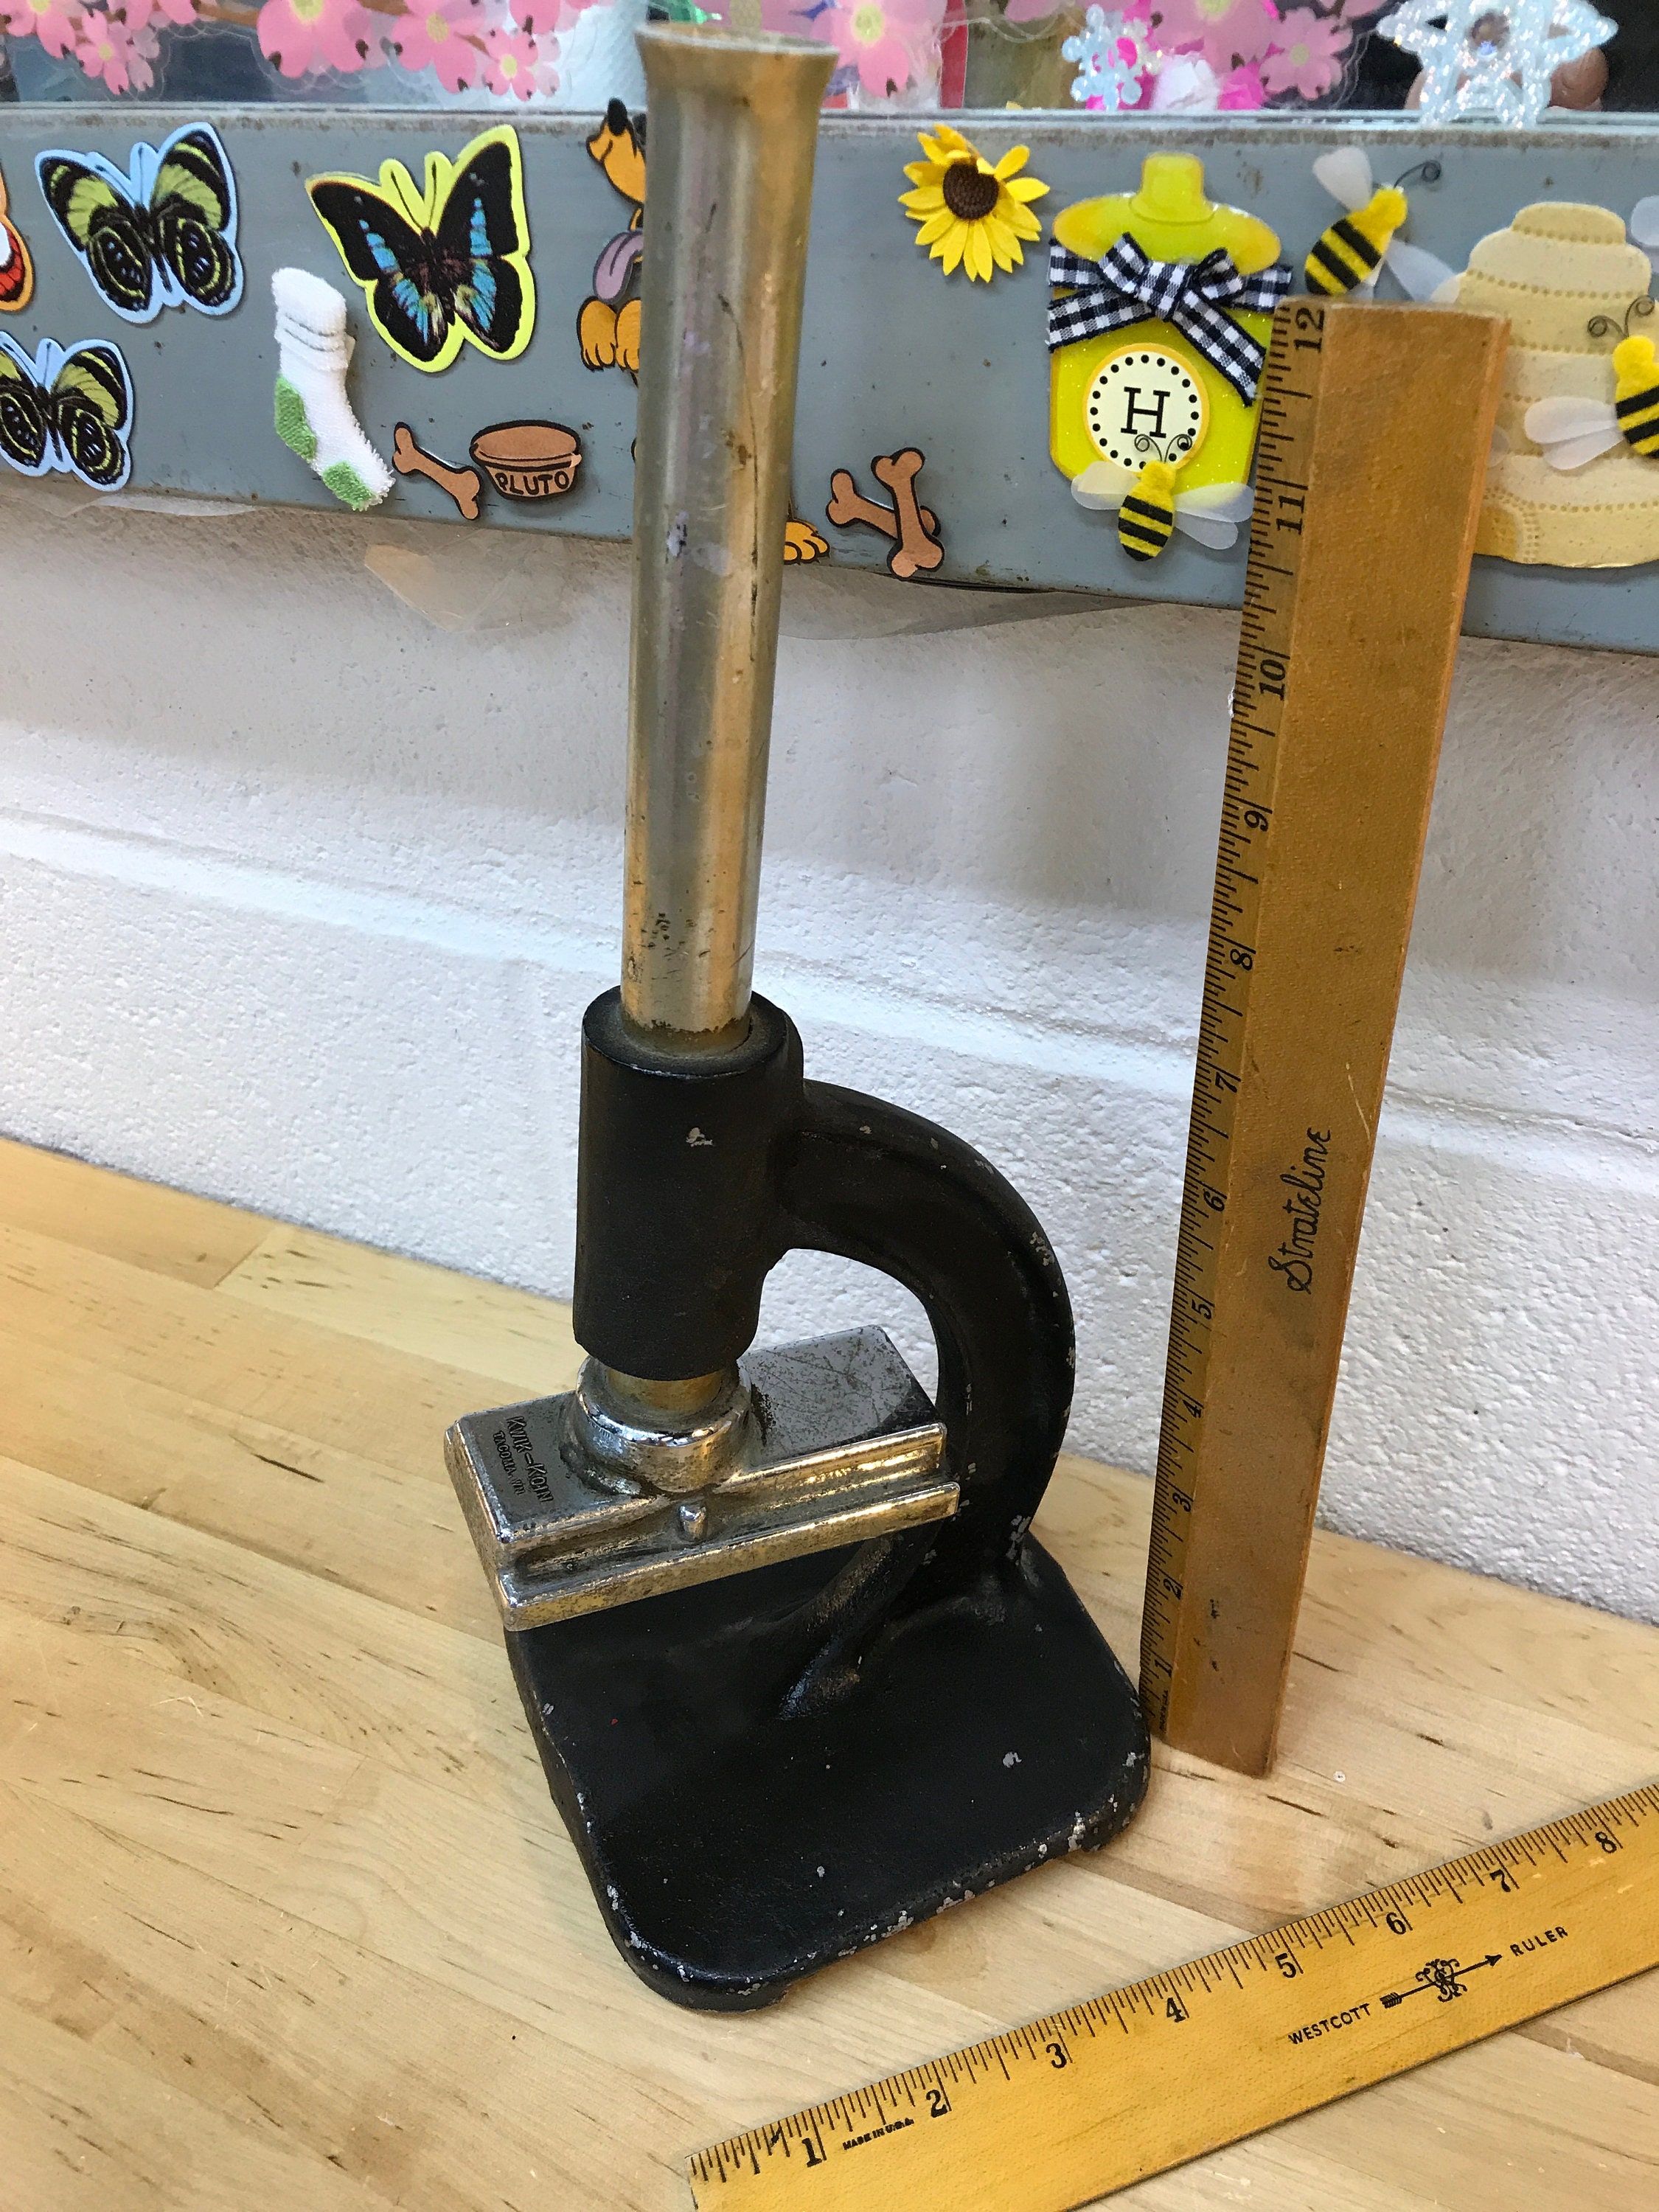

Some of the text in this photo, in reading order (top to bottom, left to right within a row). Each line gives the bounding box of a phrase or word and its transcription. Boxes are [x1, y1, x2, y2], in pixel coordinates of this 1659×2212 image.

[1293, 307, 1325, 353] 12
[1120, 386, 1171, 438] H
[494, 470, 569, 495] PLUTO
[1276, 491, 1306, 536] 11
[1259, 658, 1286, 701] 10
[1244, 810, 1269, 832] 9
[1230, 947, 1253, 972] 8
[1215, 1076, 1239, 1094] 7
[1203, 1188, 1226, 1213] 6
[1267, 1127, 1332, 1295] Strateline
[1192, 1298, 1212, 1321] 5
[1183, 1399, 1202, 1419] 4
[1172, 1492, 1192, 1512] 3
[1163, 1578, 1182, 1601] 2
[1154, 1659, 1172, 1679] 1
[1595, 1831, 1617, 1854] 8
[1490, 1870, 1512, 1893] 7
[1385, 1913, 1407, 1935] 6
[1510, 1925, 1569, 1958] RULER
[1276, 1952, 1298, 1979] 5
[1165, 1997, 1186, 2023] 4
[1287, 2002, 1372, 2045] WESTCOTT
[1046, 2042, 1068, 2069] 3
[925, 2089, 948, 2118] 2
[801, 2137, 823, 2168] 1
